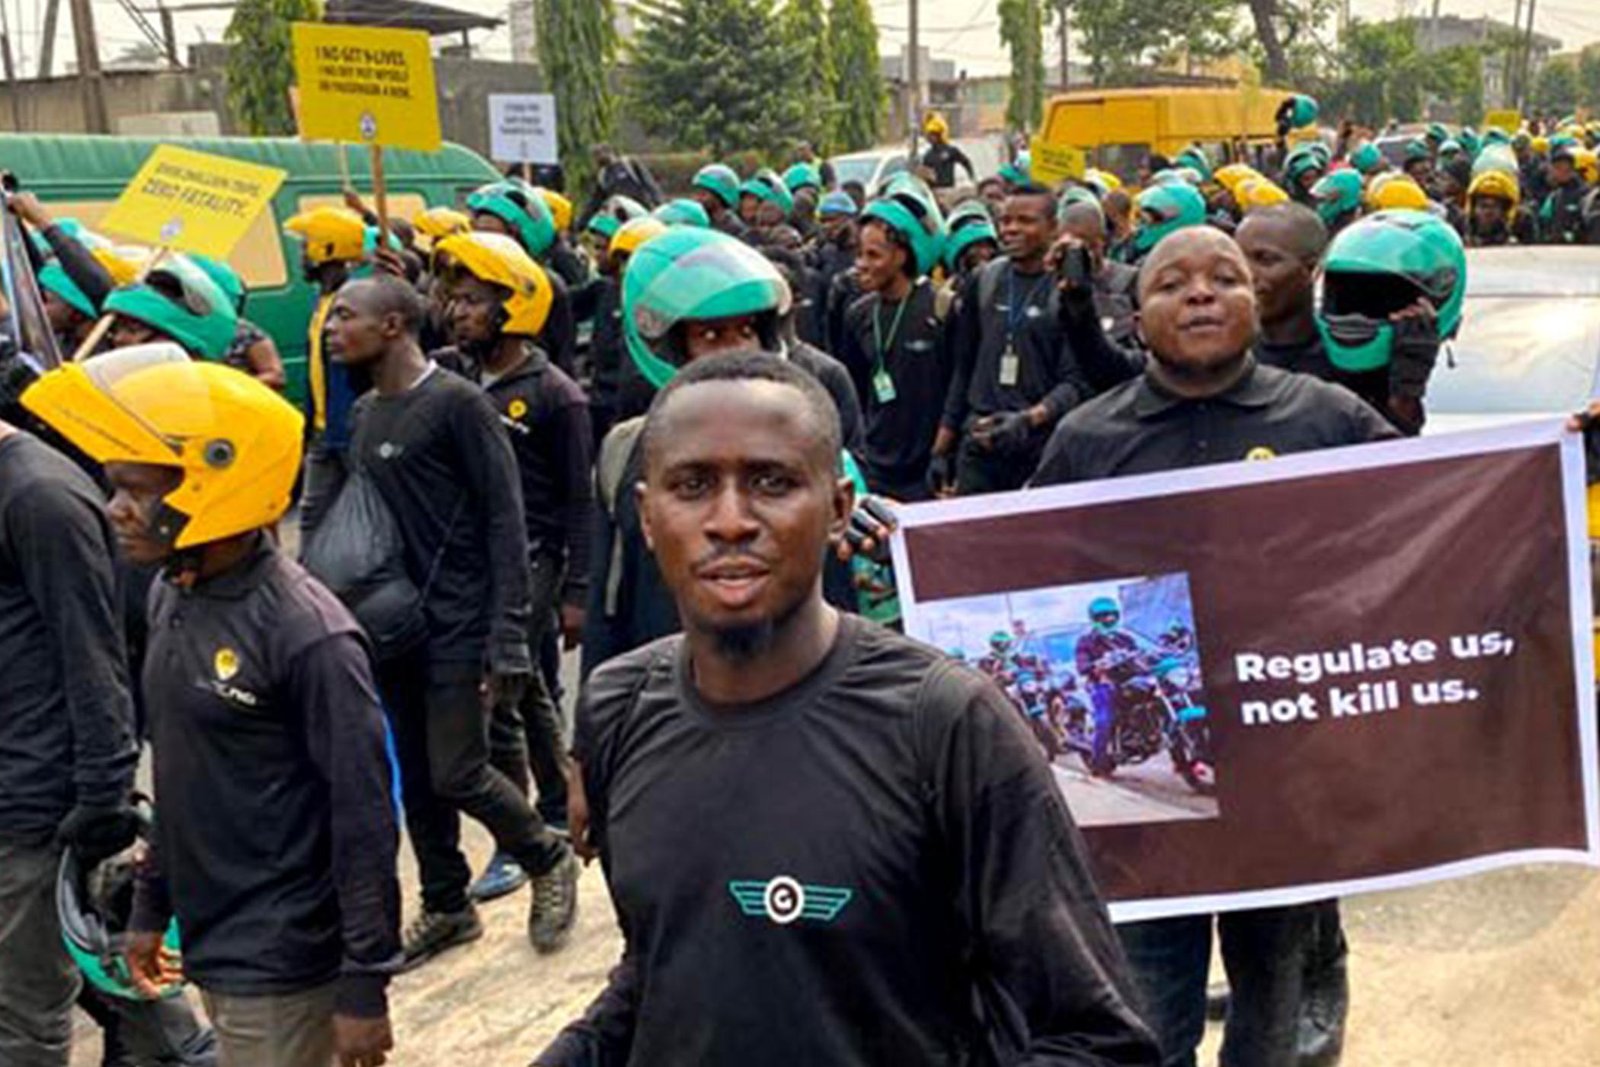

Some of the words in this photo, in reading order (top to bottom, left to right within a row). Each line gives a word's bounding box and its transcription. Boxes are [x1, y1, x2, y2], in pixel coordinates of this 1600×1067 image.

[142, 177, 180, 199] ZERO
[1235, 639, 1437, 682] Regulate
[1449, 631, 1514, 657] us,
[1241, 693, 1319, 724] not
[1329, 681, 1400, 717] kill
[1412, 679, 1478, 704] us.
